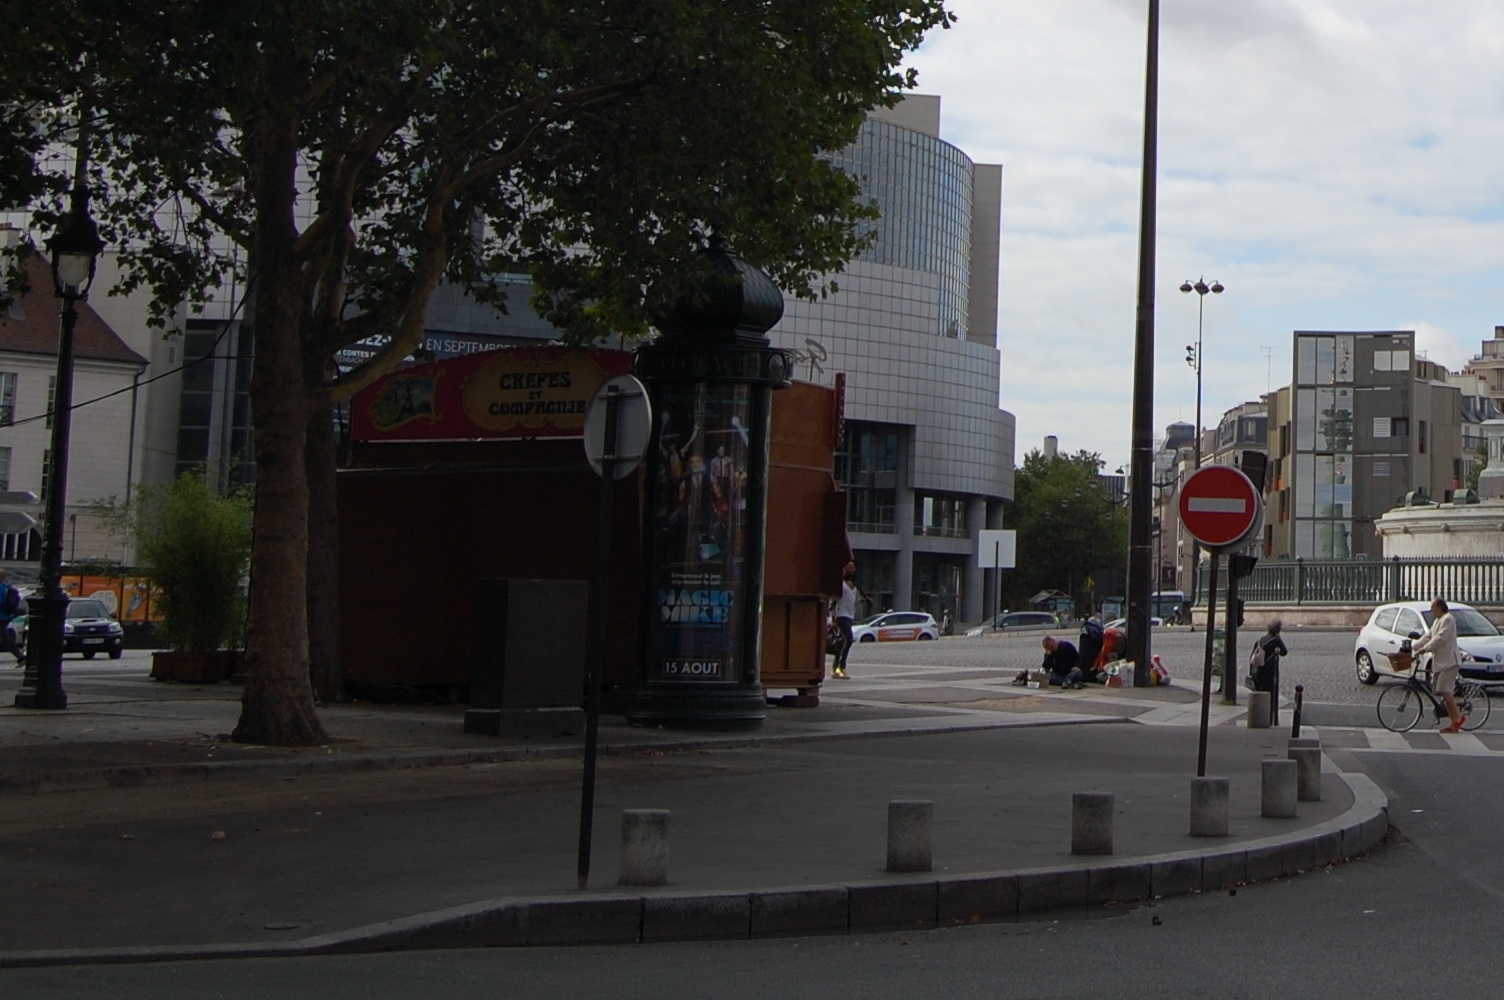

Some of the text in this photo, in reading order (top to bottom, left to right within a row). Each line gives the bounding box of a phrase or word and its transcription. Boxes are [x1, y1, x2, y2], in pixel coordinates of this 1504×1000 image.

[426, 338, 442, 351] EN
[529, 390, 543, 400] ET
[488, 400, 587, 415] COMPAGNIE
[657, 589, 735, 606] MAGIC
[660, 605, 729, 622] MIKE
[665, 661, 719, 674] 15 AOUT
